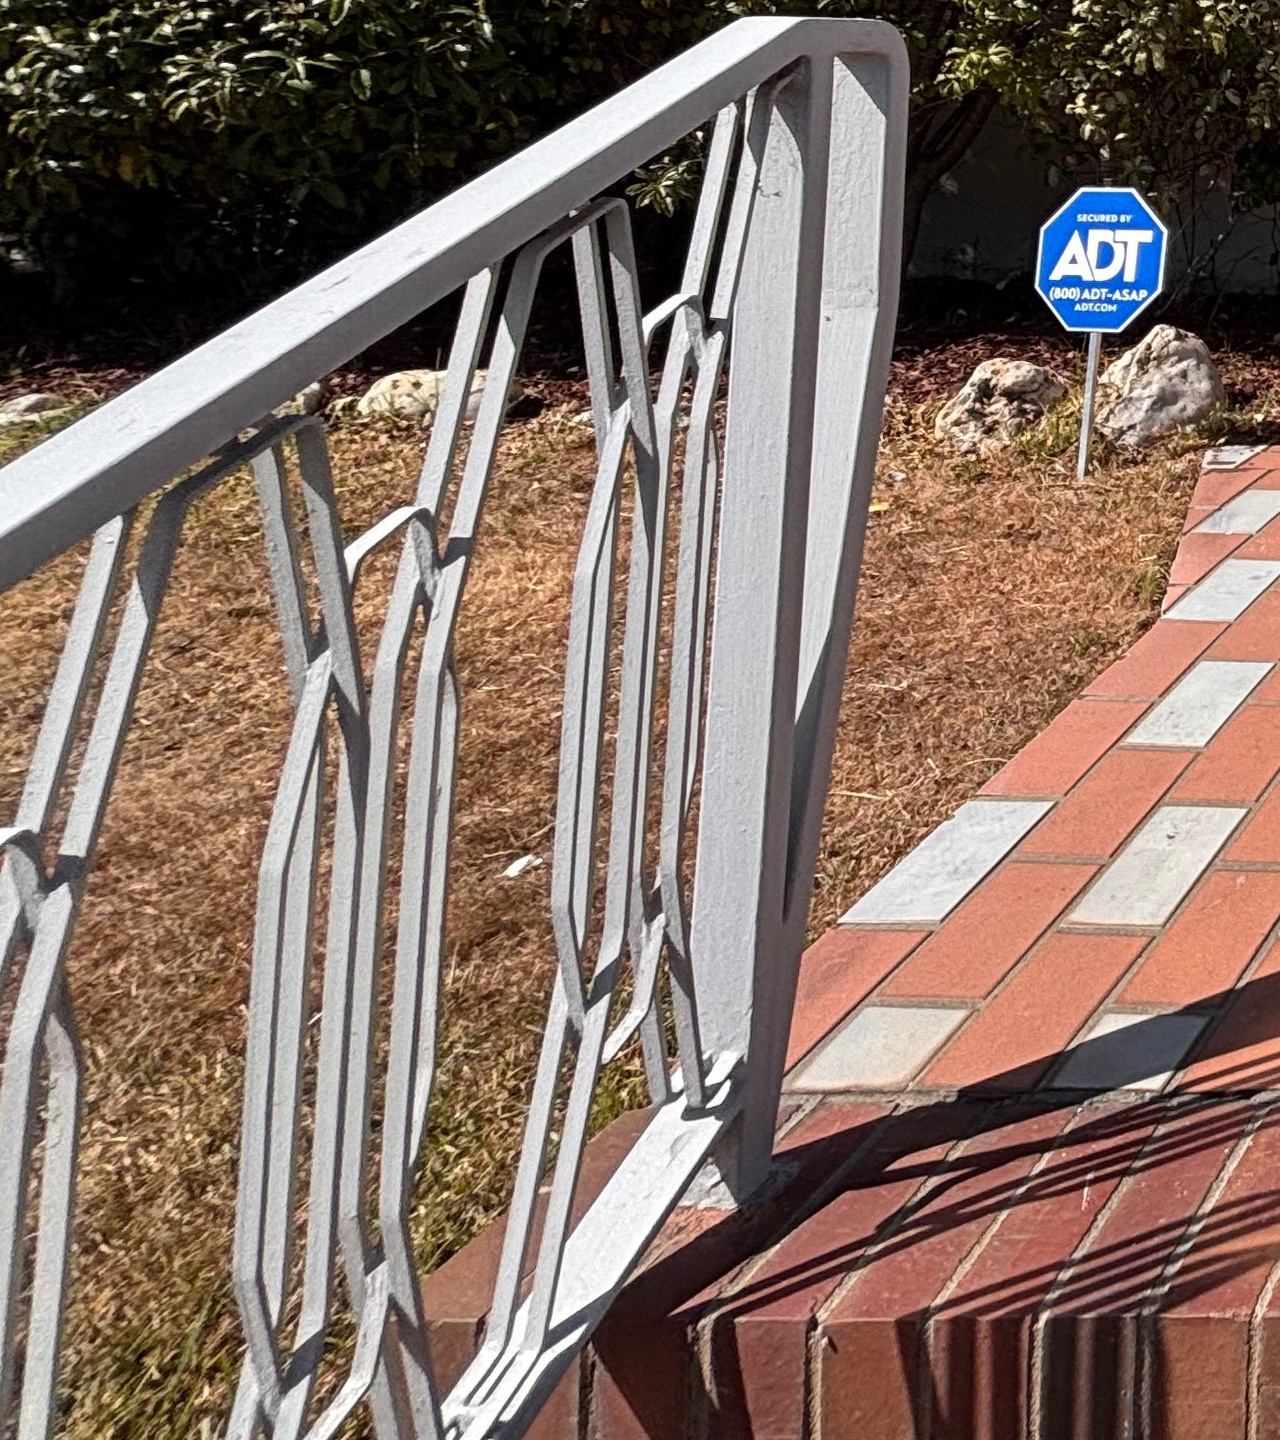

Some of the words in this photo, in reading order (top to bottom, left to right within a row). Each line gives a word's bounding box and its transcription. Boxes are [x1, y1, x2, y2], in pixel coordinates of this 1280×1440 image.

[1076, 214, 1118, 222] SECURED
[1119, 214, 1132, 223] BY
[1048, 229, 1154, 282] ADT
[1074, 303, 1117, 312] ADT.COM
